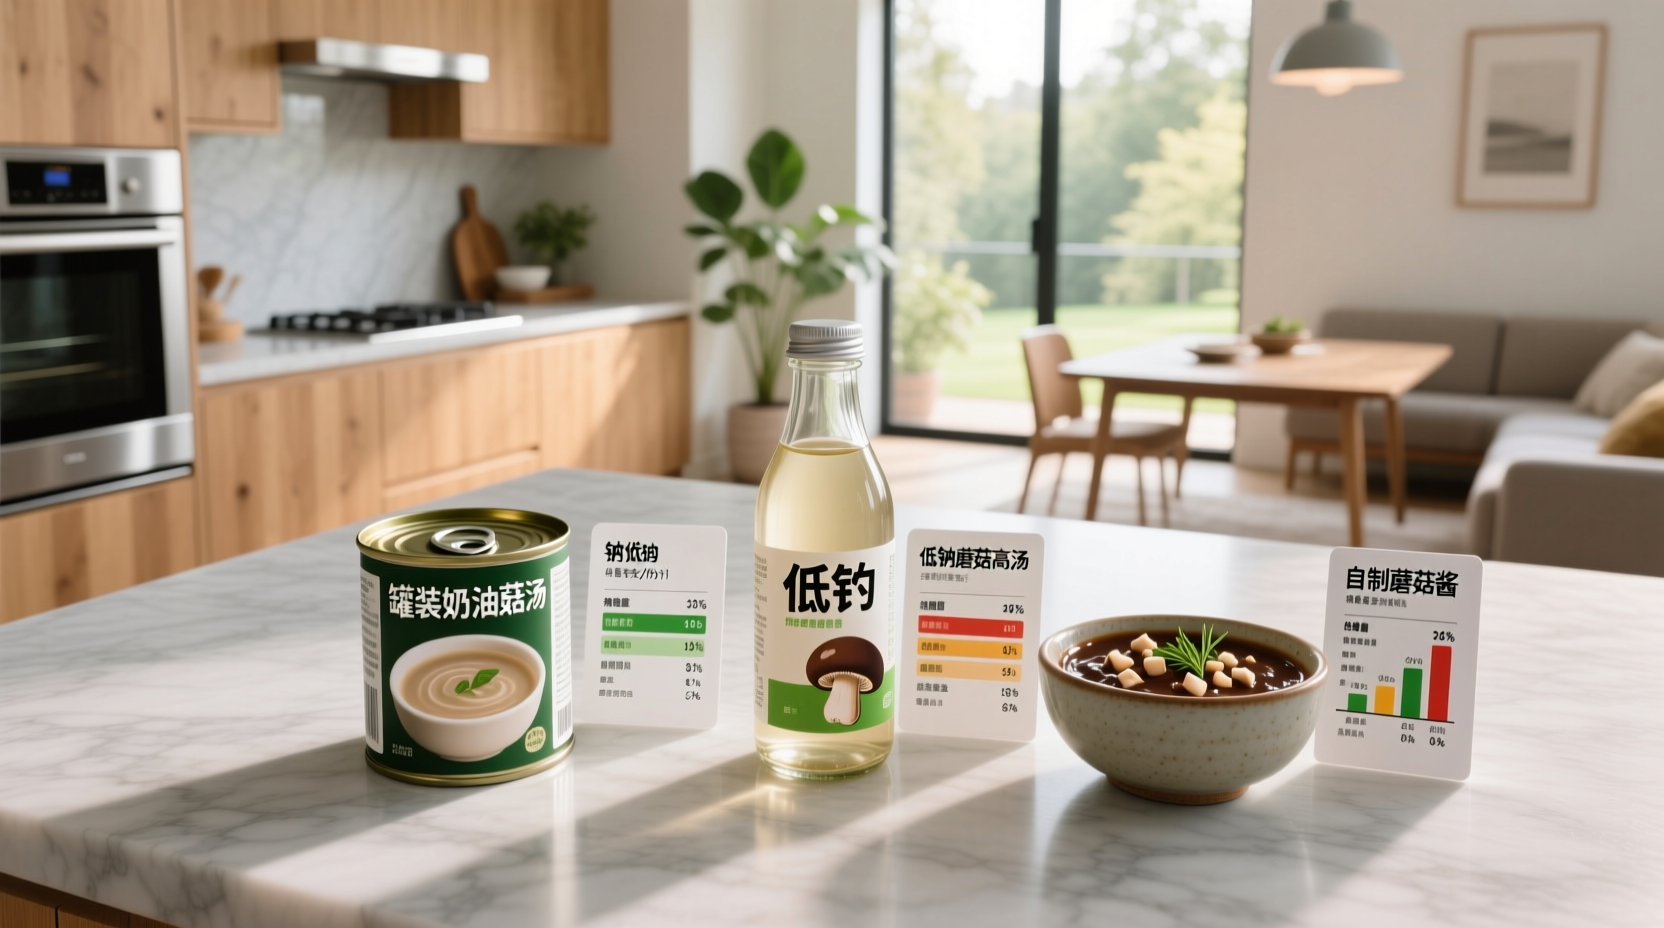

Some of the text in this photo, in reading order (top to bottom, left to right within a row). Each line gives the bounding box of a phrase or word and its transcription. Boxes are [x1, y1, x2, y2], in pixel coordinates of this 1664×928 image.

[388, 577, 547, 620] 罐装奶油菇汤
